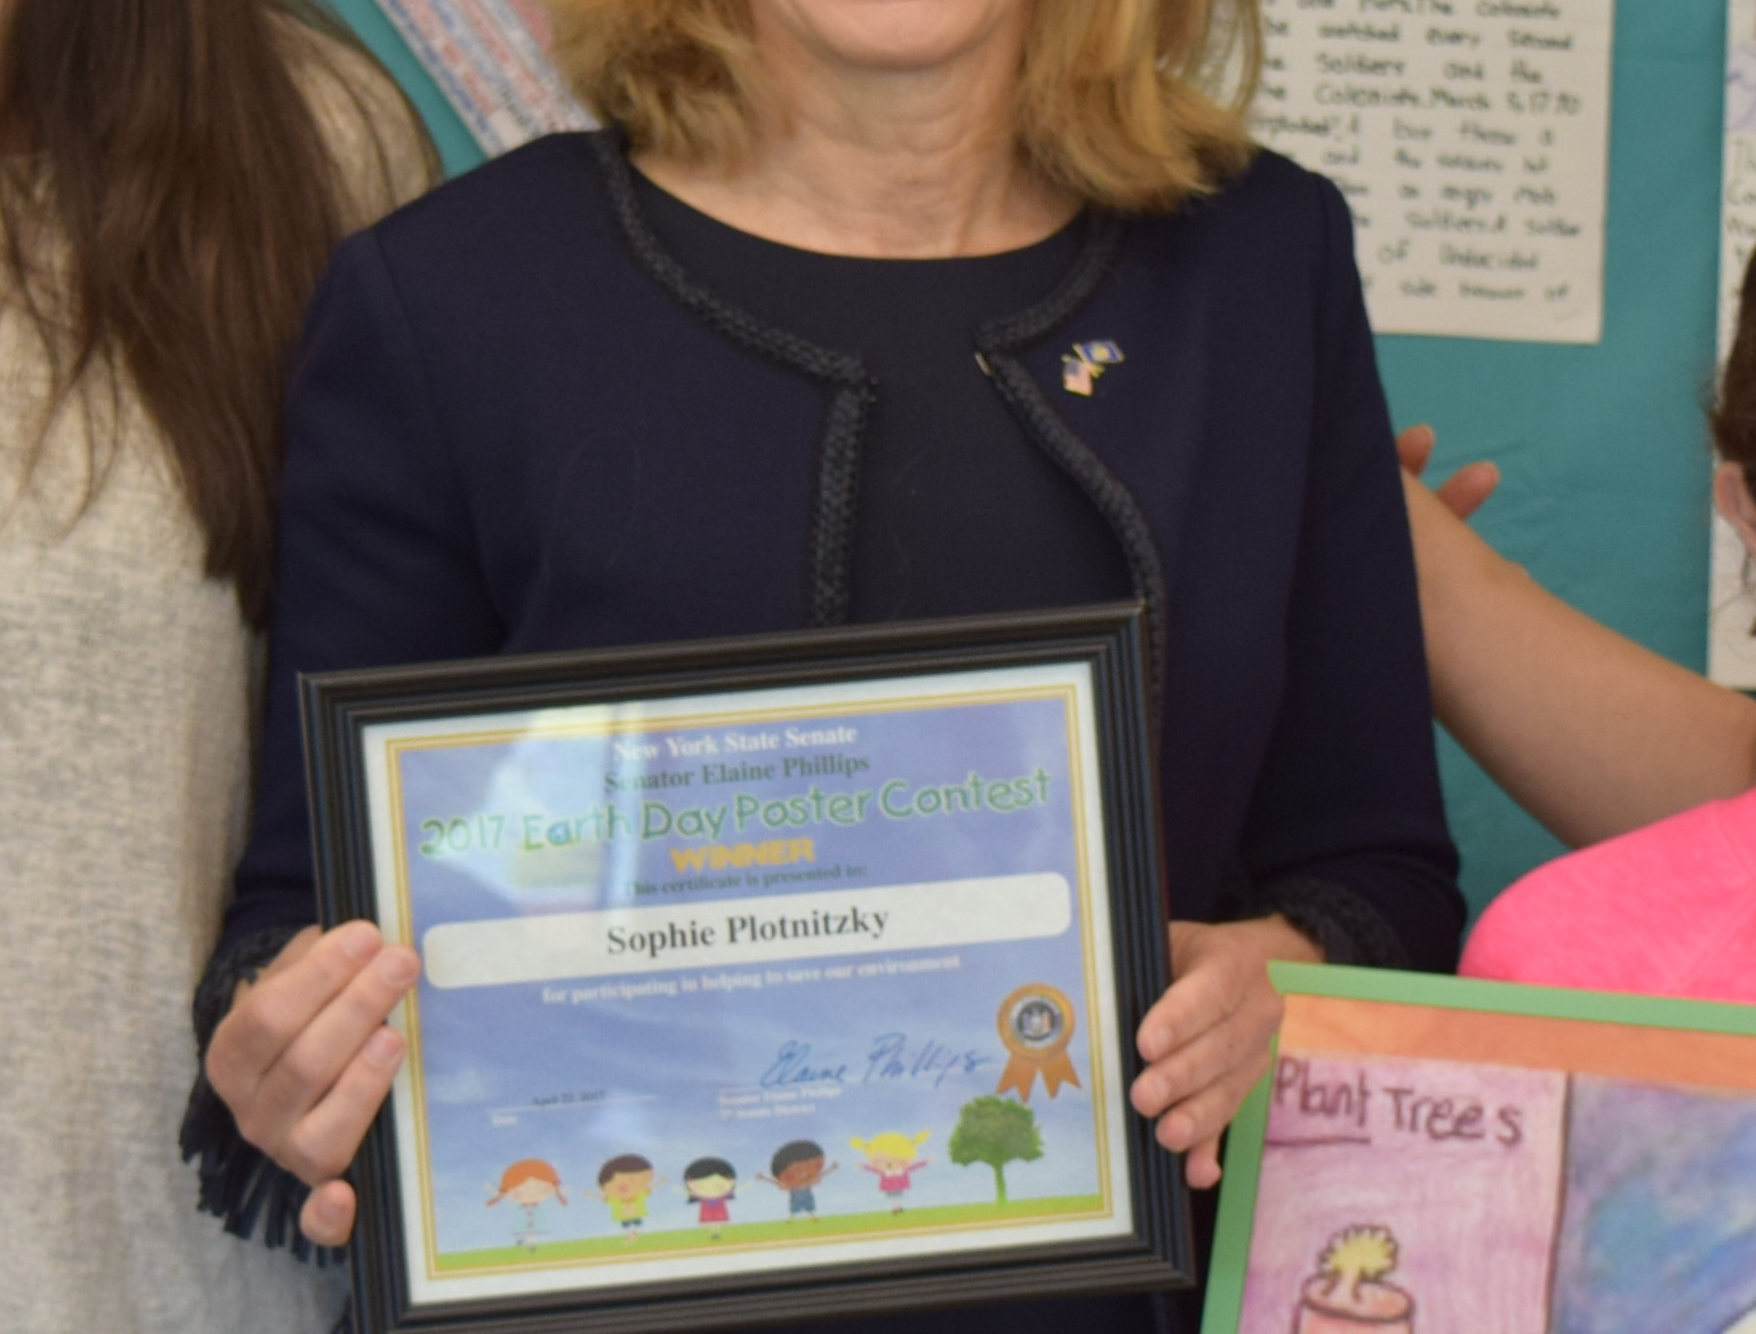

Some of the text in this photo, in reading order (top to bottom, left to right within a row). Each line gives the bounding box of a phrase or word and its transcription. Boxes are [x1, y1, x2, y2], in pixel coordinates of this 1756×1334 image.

[613, 724, 858, 762] New York State Senate
[603, 752, 871, 794] Senator Elaine Phillips
[419, 765, 1053, 856] 2017 Earth Day Poster Contest
[669, 836, 817, 875] WINNER
[607, 905, 890, 958] Sophie Plotnitzky
[1275, 1055, 1372, 1129] Plant
